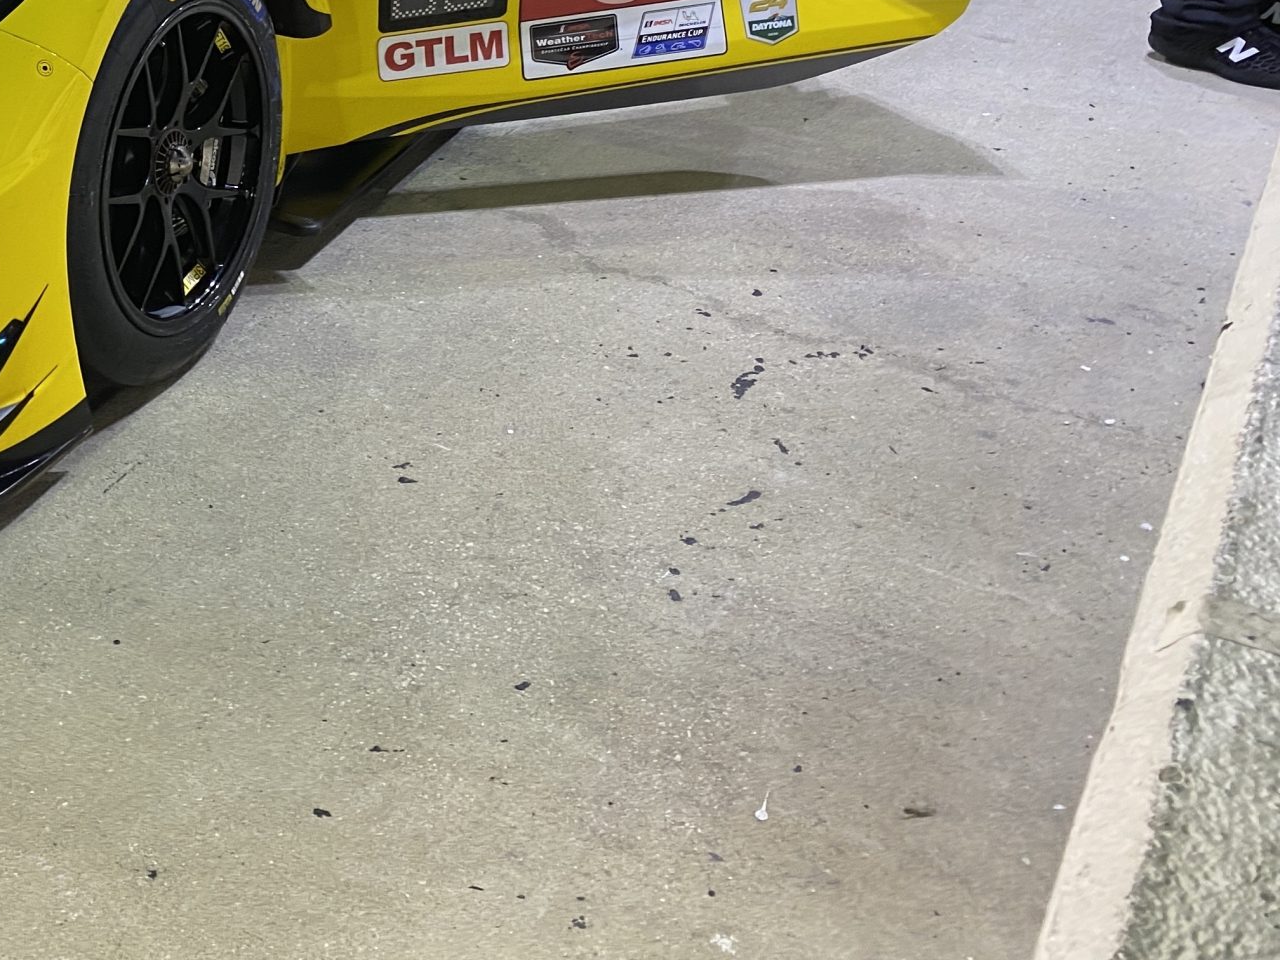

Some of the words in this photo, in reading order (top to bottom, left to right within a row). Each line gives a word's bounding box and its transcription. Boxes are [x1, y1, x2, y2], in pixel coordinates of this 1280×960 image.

[752, 19, 792, 31] DAYTONA
[641, 32, 687, 43] ENDURANCE
[687, 29, 704, 37] CUP
[385, 29, 503, 72] GTLM
